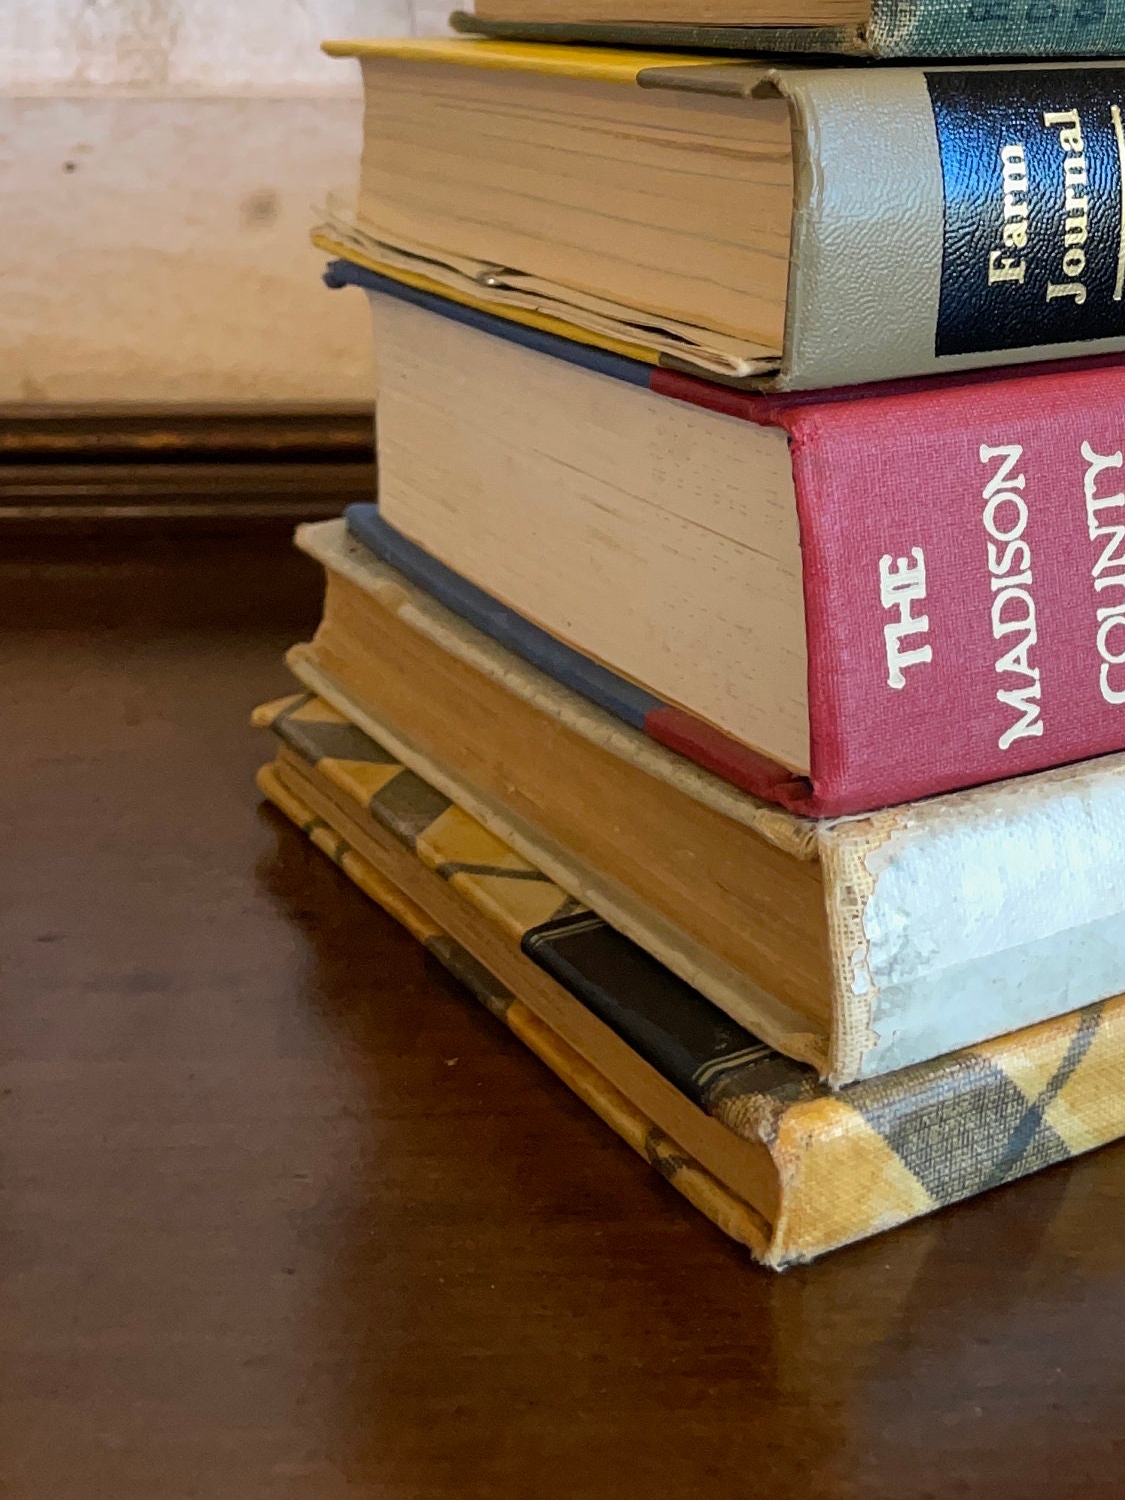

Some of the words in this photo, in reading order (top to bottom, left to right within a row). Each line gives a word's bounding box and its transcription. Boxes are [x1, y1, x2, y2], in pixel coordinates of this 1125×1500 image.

[988, 144, 1032, 286] Farm
[1043, 108, 1089, 304] Journal
[879, 547, 932, 690] THE
[979, 444, 1043, 750] MADISON
